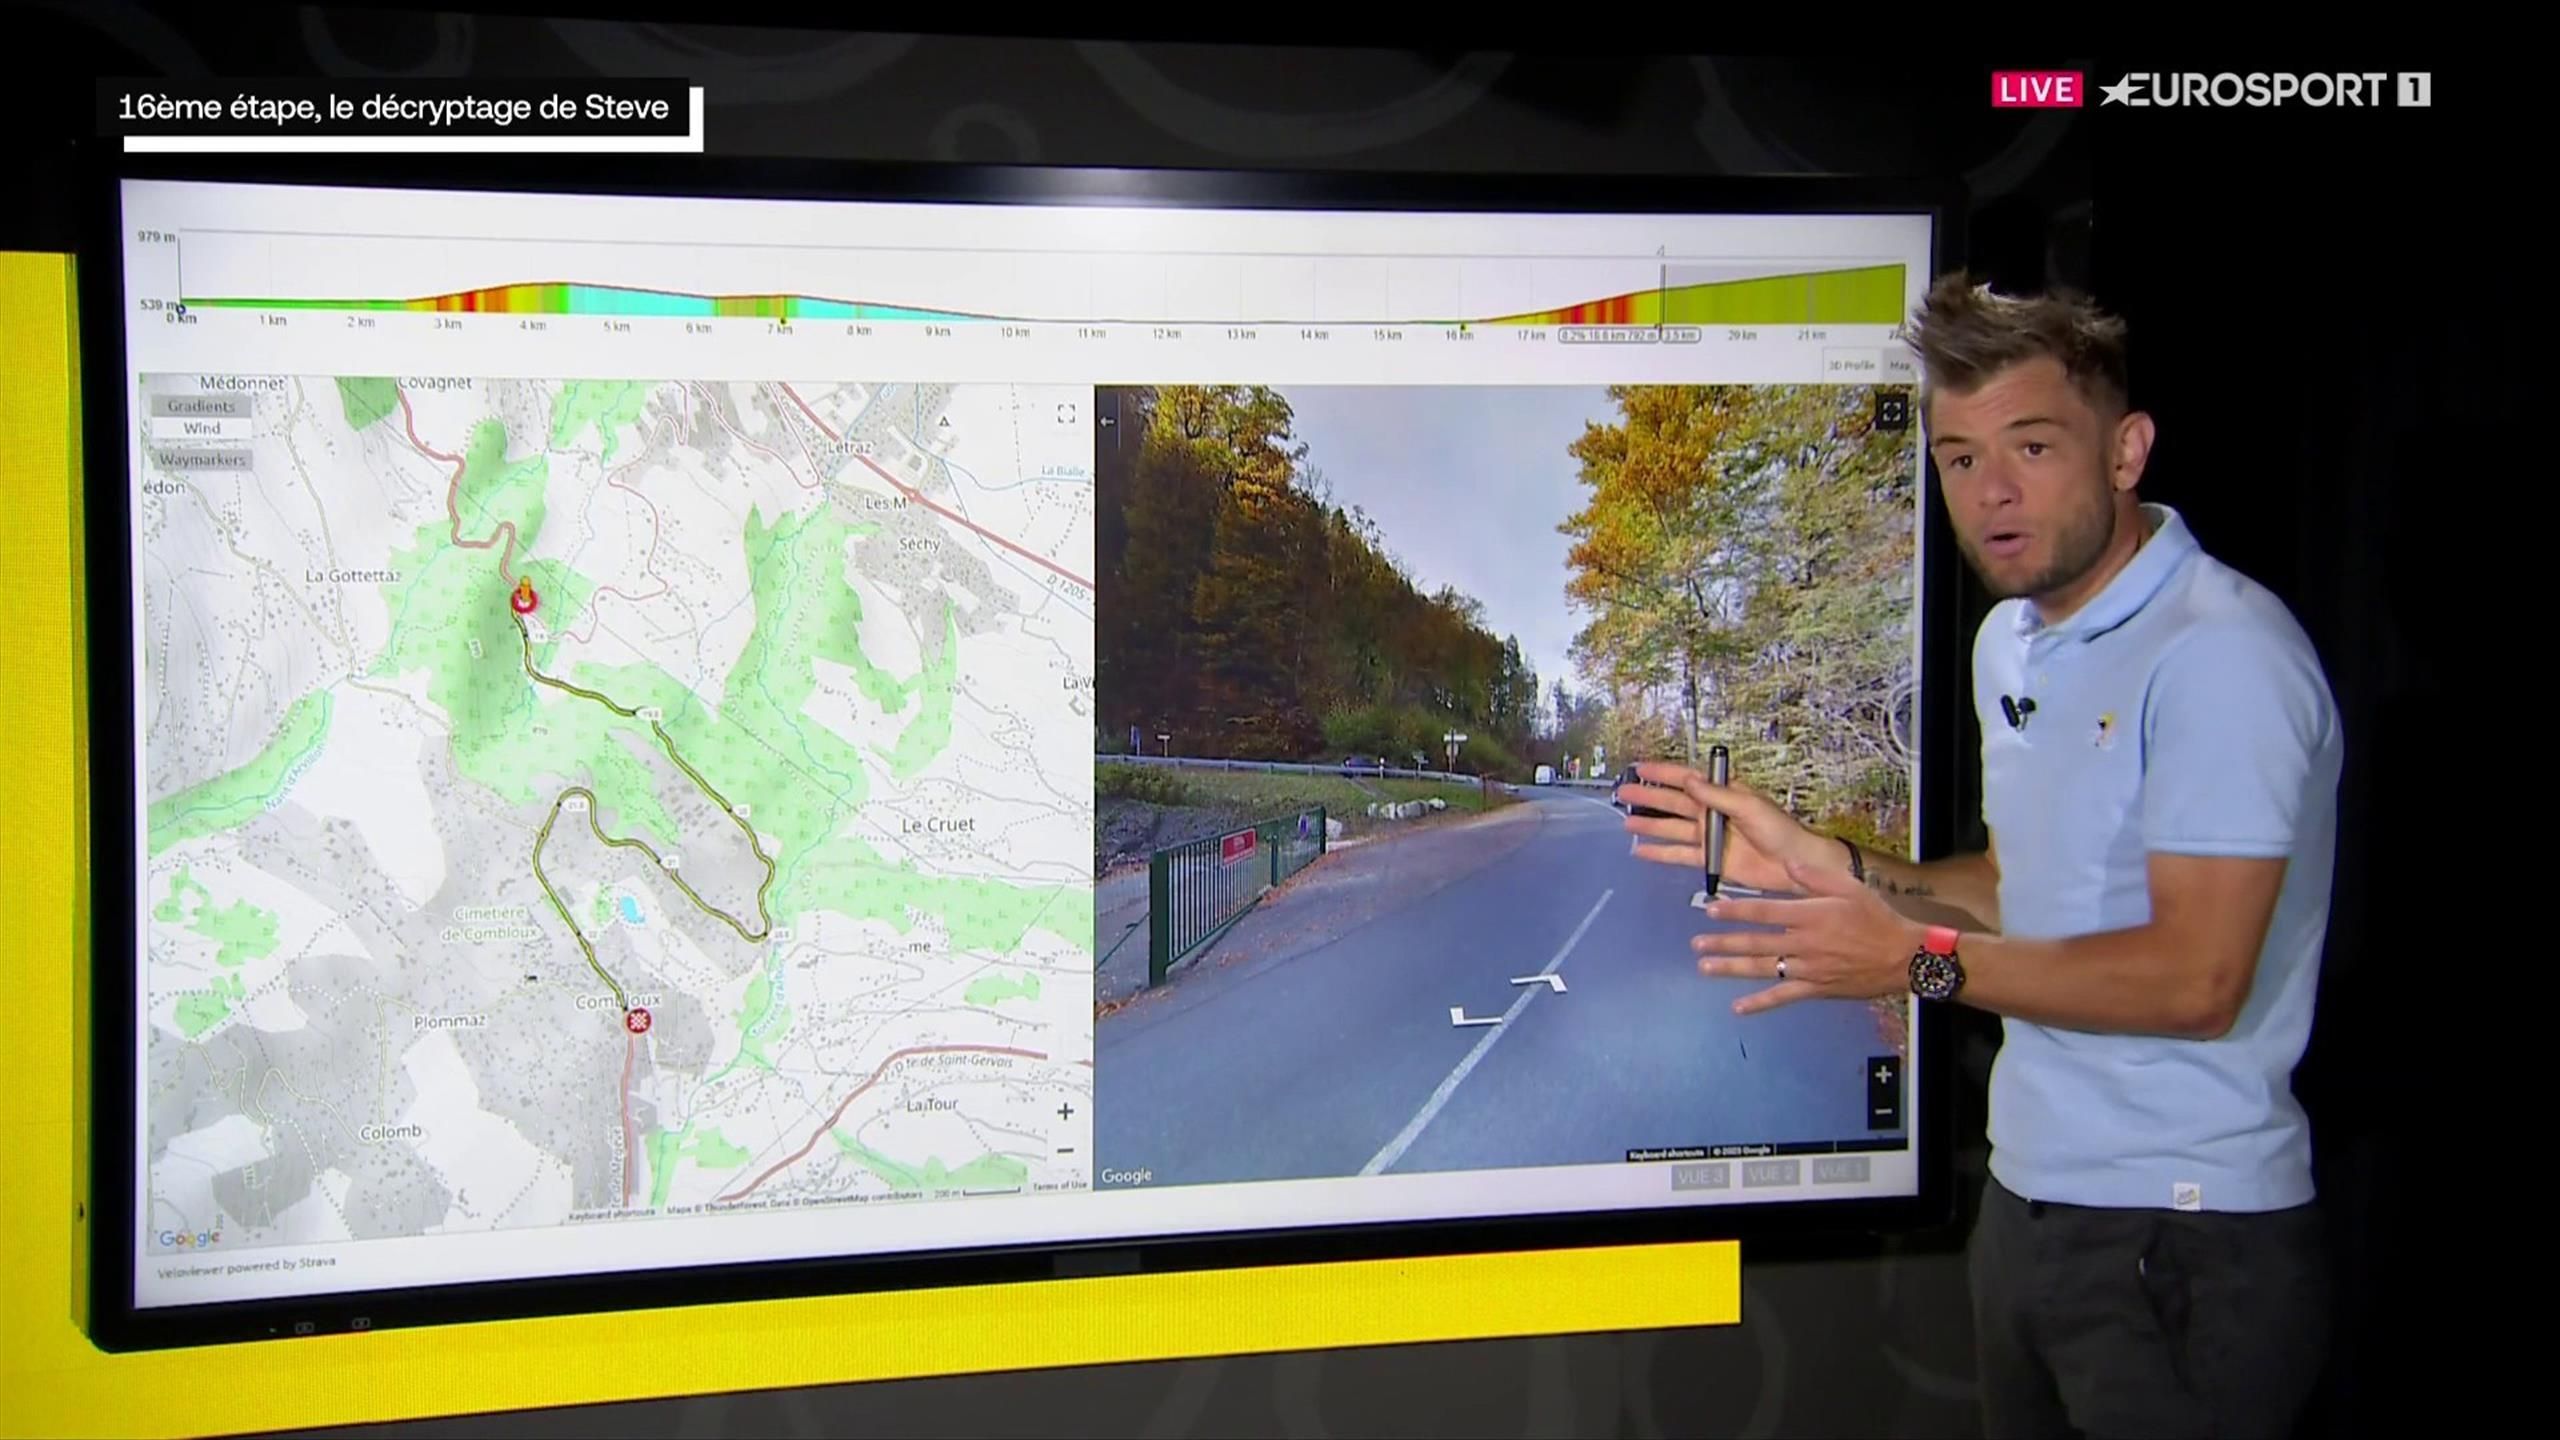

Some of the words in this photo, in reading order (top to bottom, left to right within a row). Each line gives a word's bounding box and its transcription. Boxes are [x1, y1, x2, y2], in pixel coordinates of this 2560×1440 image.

[138, 230, 162, 243] 979
[164, 234, 176, 243] m
[177, 312, 197, 324] km
[269, 314, 287, 326] km
[357, 316, 375, 328] km
[445, 317, 463, 330] km
[530, 319, 547, 331] km
[613, 320, 630, 332] km
[695, 322, 713, 334] km
[776, 323, 793, 335] km
[856, 324, 872, 336] km
[935, 325, 951, 336] km
[1014, 325, 1031, 337] km
[1091, 327, 1106, 339] km
[1166, 328, 1182, 340] km
[1240, 329, 1256, 340] km
[1313, 329, 1329, 341] km
[1386, 329, 1402, 341] km
[1459, 329, 1474, 341] km
[1530, 329, 1546, 341] km
[1742, 330, 1757, 341] km
[1812, 330, 1827, 341] km
[200, 375, 285, 391] Médonnet
[168, 400, 236, 413] Gradients
[184, 422, 221, 435] Wind
[159, 453, 247, 467] Waymarkers
[866, 496, 891, 509] Les
[893, 497, 906, 509] M
[306, 569, 325, 582] La
[329, 569, 402, 583] Gottettaz
[902, 818, 922, 834] Le
[927, 817, 976, 833] Cruet
[463, 926, 539, 941] Combloux
[414, 1014, 487, 1029] Plommaz
[938, 1054, 1014, 1069] Saint-Gervais
[906, 1100, 922, 1113] La
[927, 1098, 959, 1112] Tour
[360, 1125, 422, 1141] Colomb
[1101, 1167, 1153, 1185] Google
[1678, 1166, 1711, 1185] VUE
[1749, 1165, 1781, 1183] VUE
[1033, 1182, 1058, 1191] Terms
[1071, 1180, 1088, 1190] Use
[159, 1229, 221, 1248] Google
[226, 1259, 280, 1276] powered
[282, 1258, 297, 1272] by
[299, 1256, 336, 1270] Strava
